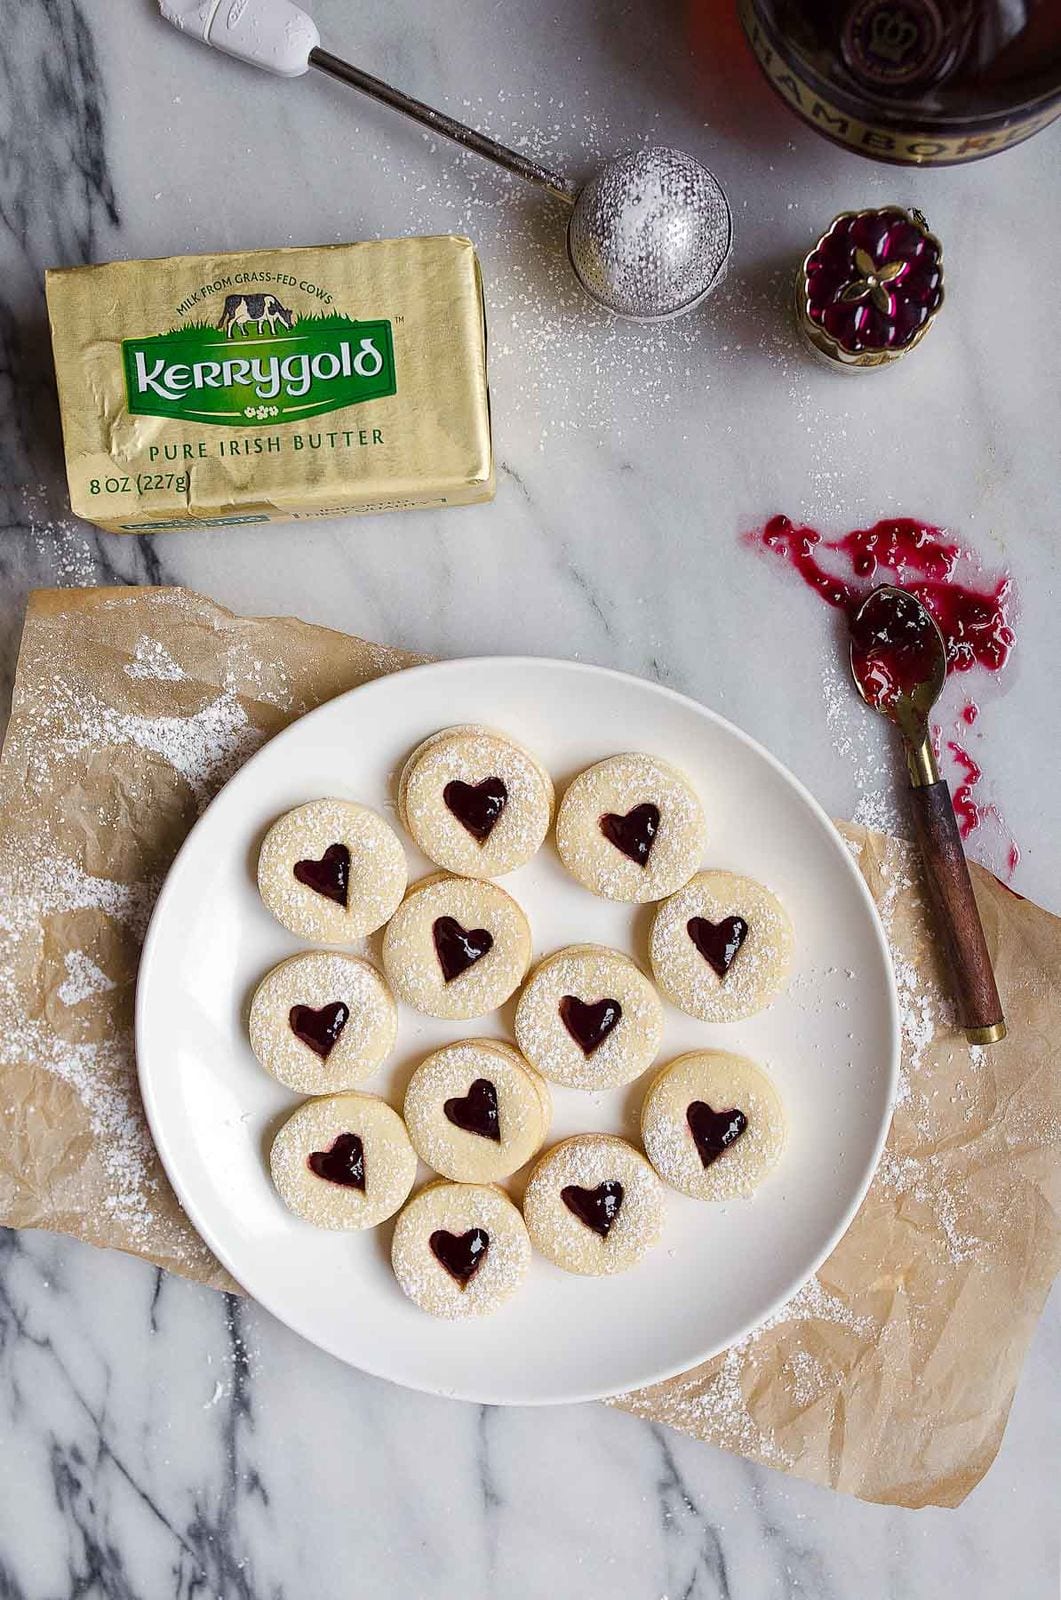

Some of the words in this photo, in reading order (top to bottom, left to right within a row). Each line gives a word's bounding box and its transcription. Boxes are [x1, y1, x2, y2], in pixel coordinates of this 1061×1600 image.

[176, 292, 201, 316] MILK
[201, 276, 232, 299] FROM
[234, 271, 297, 287] GRASS-FED
[299, 280, 334, 305] COWS
[149, 442, 208, 462] PURE
[220, 436, 281, 457] IRISH
[294, 429, 385, 450] BUTTER
[90, 479, 101, 495] 8
[105, 474, 132, 494] OZ
[136, 470, 191, 496] (227g)
